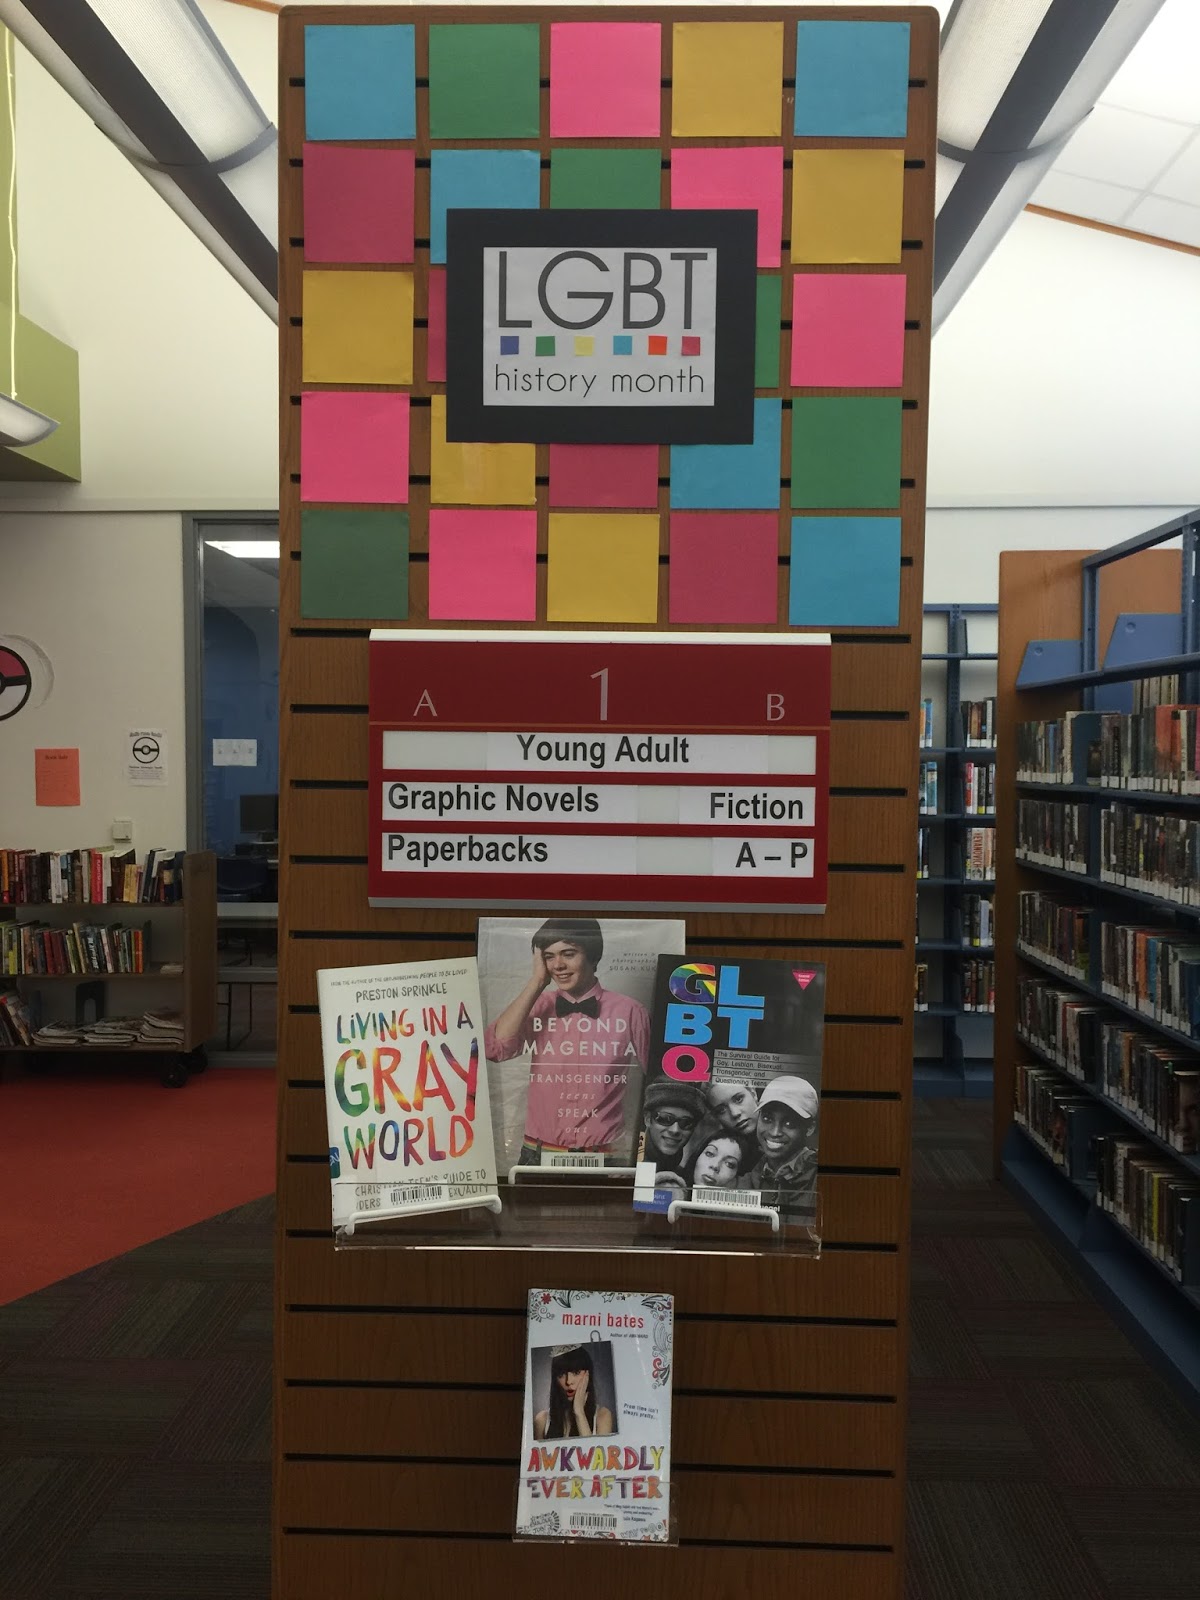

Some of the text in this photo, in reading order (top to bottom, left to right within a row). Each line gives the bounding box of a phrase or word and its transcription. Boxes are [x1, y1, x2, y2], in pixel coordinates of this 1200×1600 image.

[498, 250, 708, 330] LGBT
[495, 363, 704, 398] history month
[413, 688, 438, 717] A
[589, 667, 609, 721] 1
[766, 693, 785, 721] B
[516, 734, 690, 769] Young Adult
[388, 783, 599, 816] Graphic Novels
[709, 791, 804, 820] Fiction
[388, 834, 549, 867] Paperbacks
[419, 971, 437, 979] PEOPLE
[452, 968, 468, 976] LOVED
[355, 987, 399, 1003] PRESTON
[422, 1005, 448, 1037] IN
[457, 1001, 474, 1030] A
[533, 1017, 627, 1033] BEYOND
[522, 1039, 637, 1056] MAGENTA
[334, 1037, 479, 1122] GRAY
[529, 1073, 628, 1084] TRANSGENDER
[715, 1077, 749, 1086] Questioning
[559, 1092, 596, 1100] teens
[557, 1108, 599, 1118] SPEAK
[343, 1115, 474, 1170] WORLD
[565, 1126, 588, 1134] out
[475, 1169, 487, 1180] TO
[448, 1184, 489, 1197] EXUALITY
[562, 1312, 644, 1328] marni bates
[527, 1445, 664, 1473] AWKWARDLY
[527, 1474, 664, 1500] EVER AFTER
